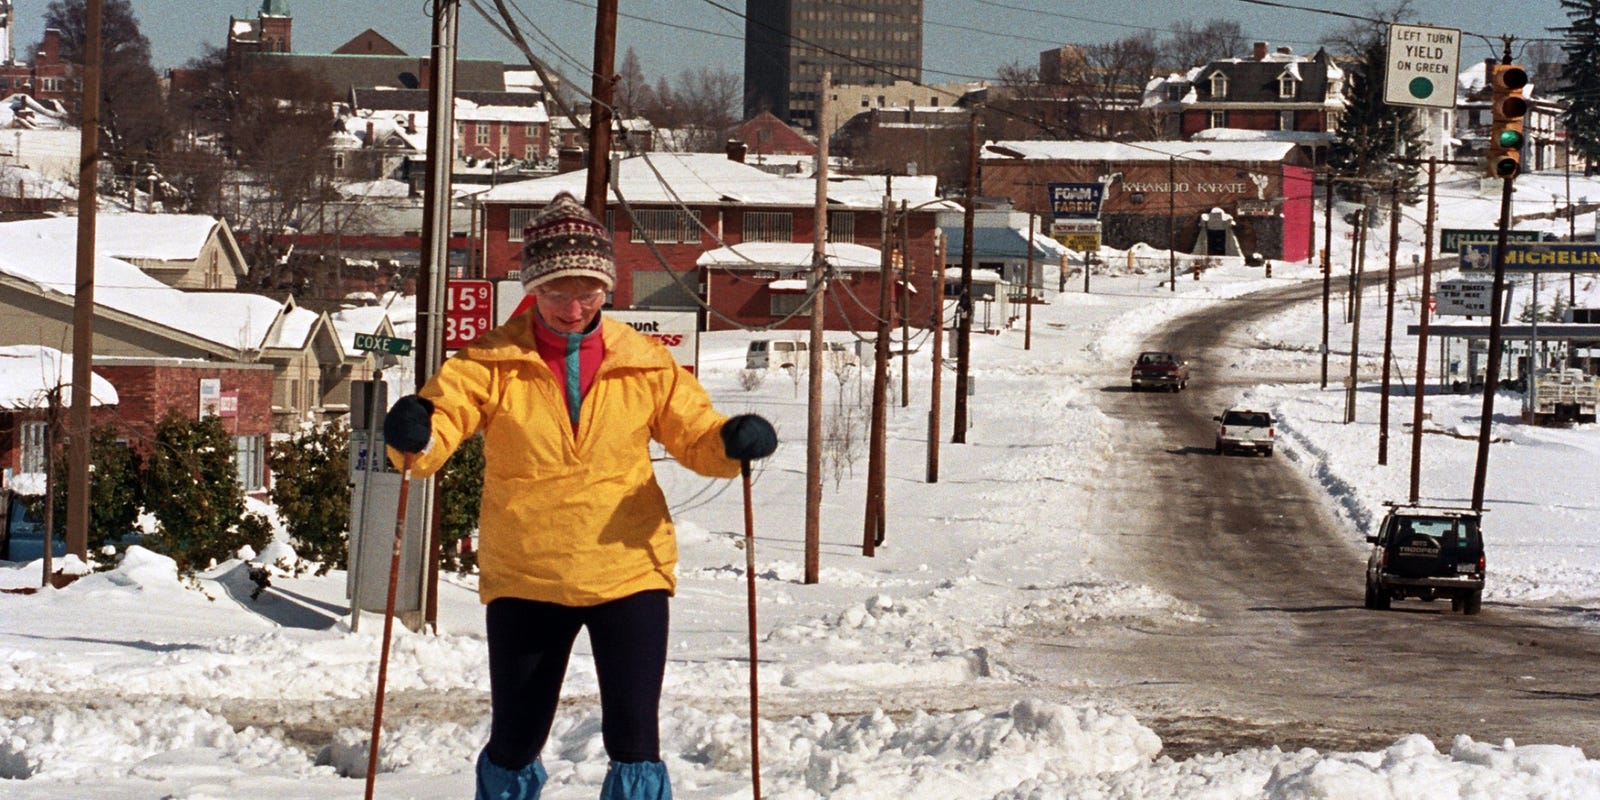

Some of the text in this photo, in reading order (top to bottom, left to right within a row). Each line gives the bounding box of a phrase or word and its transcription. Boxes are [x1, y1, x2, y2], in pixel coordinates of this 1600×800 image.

[1397, 30, 1453, 44] LEFT TURN
[1406, 45, 1443, 59] YIELD
[1397, 60, 1449, 74] ON GREEN
[1055, 187, 1092, 200] FOAM
[1198, 183, 1247, 194] KARATE
[1054, 201, 1097, 212] FABRIC
[356, 335, 391, 351] COXE
[1400, 546, 1440, 554] TROOPER
